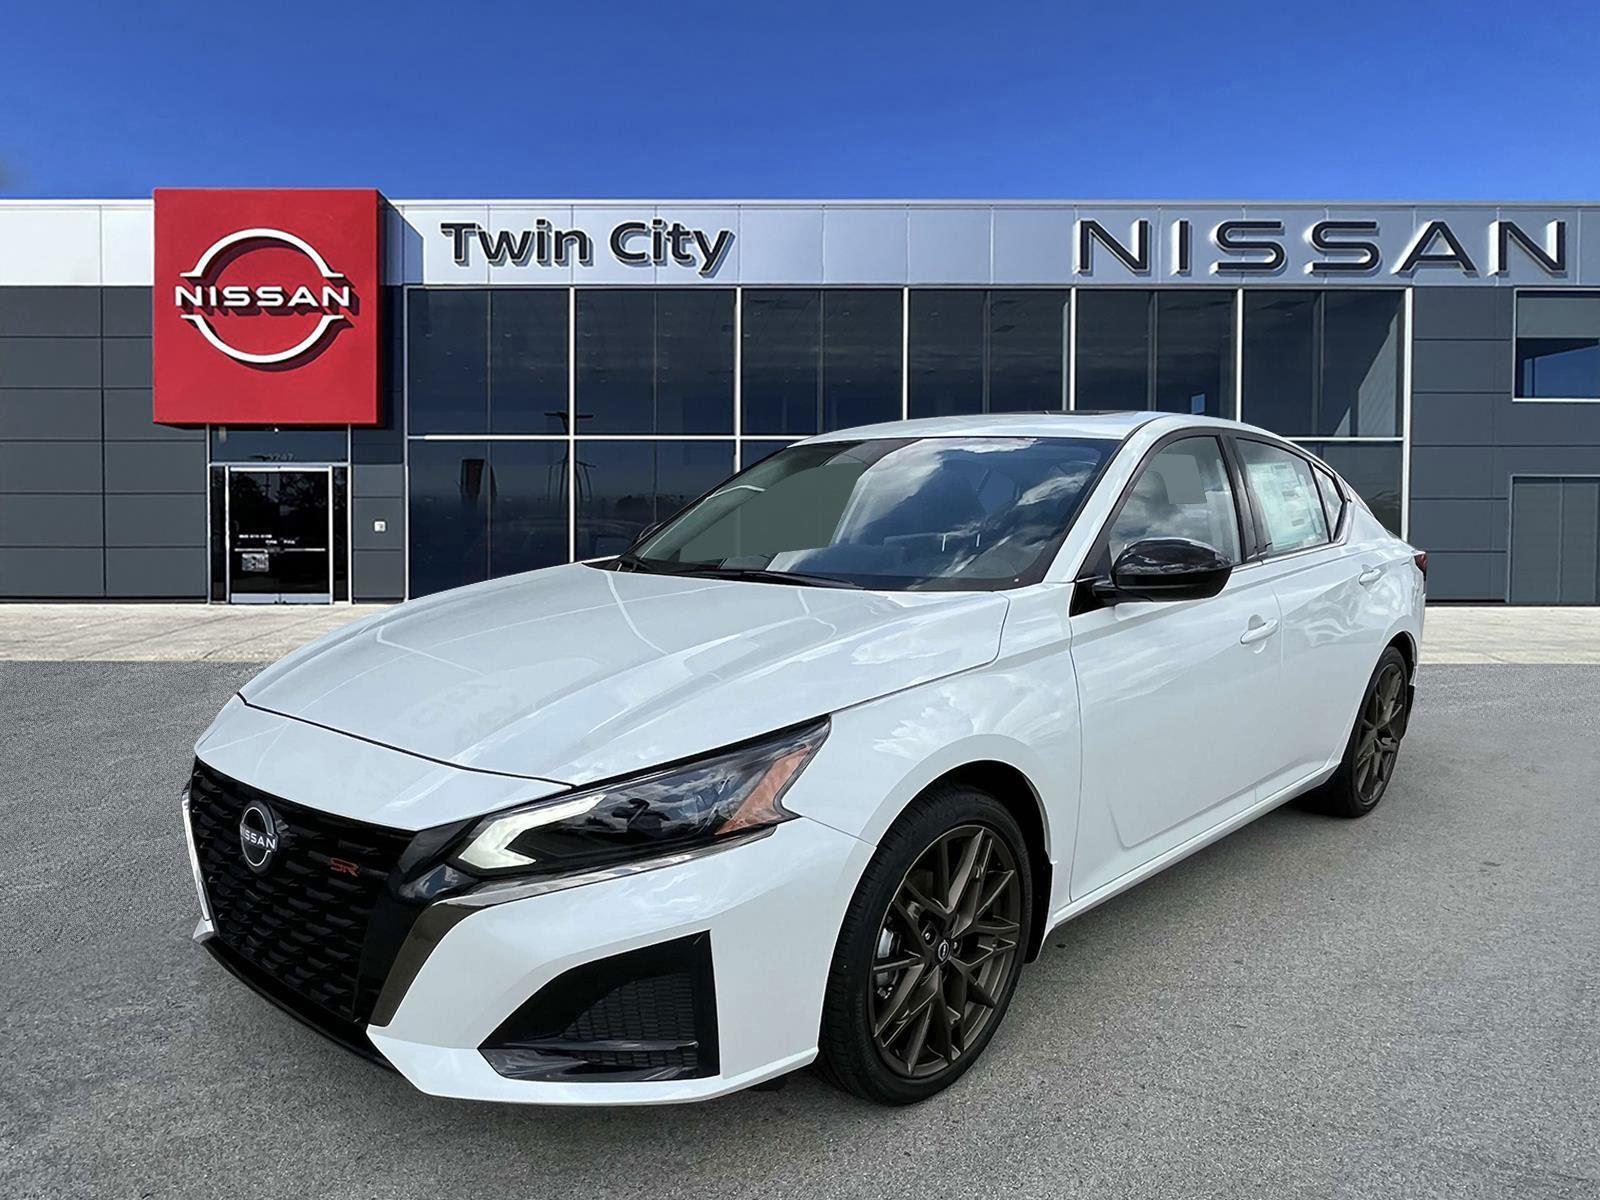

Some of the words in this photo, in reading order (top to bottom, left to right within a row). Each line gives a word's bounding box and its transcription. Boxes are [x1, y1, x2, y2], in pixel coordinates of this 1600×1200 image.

[440, 218, 592, 264] Twin
[609, 218, 735, 276] City
[1075, 219, 1568, 275] NISSAN
[174, 285, 351, 308] NISSAN
